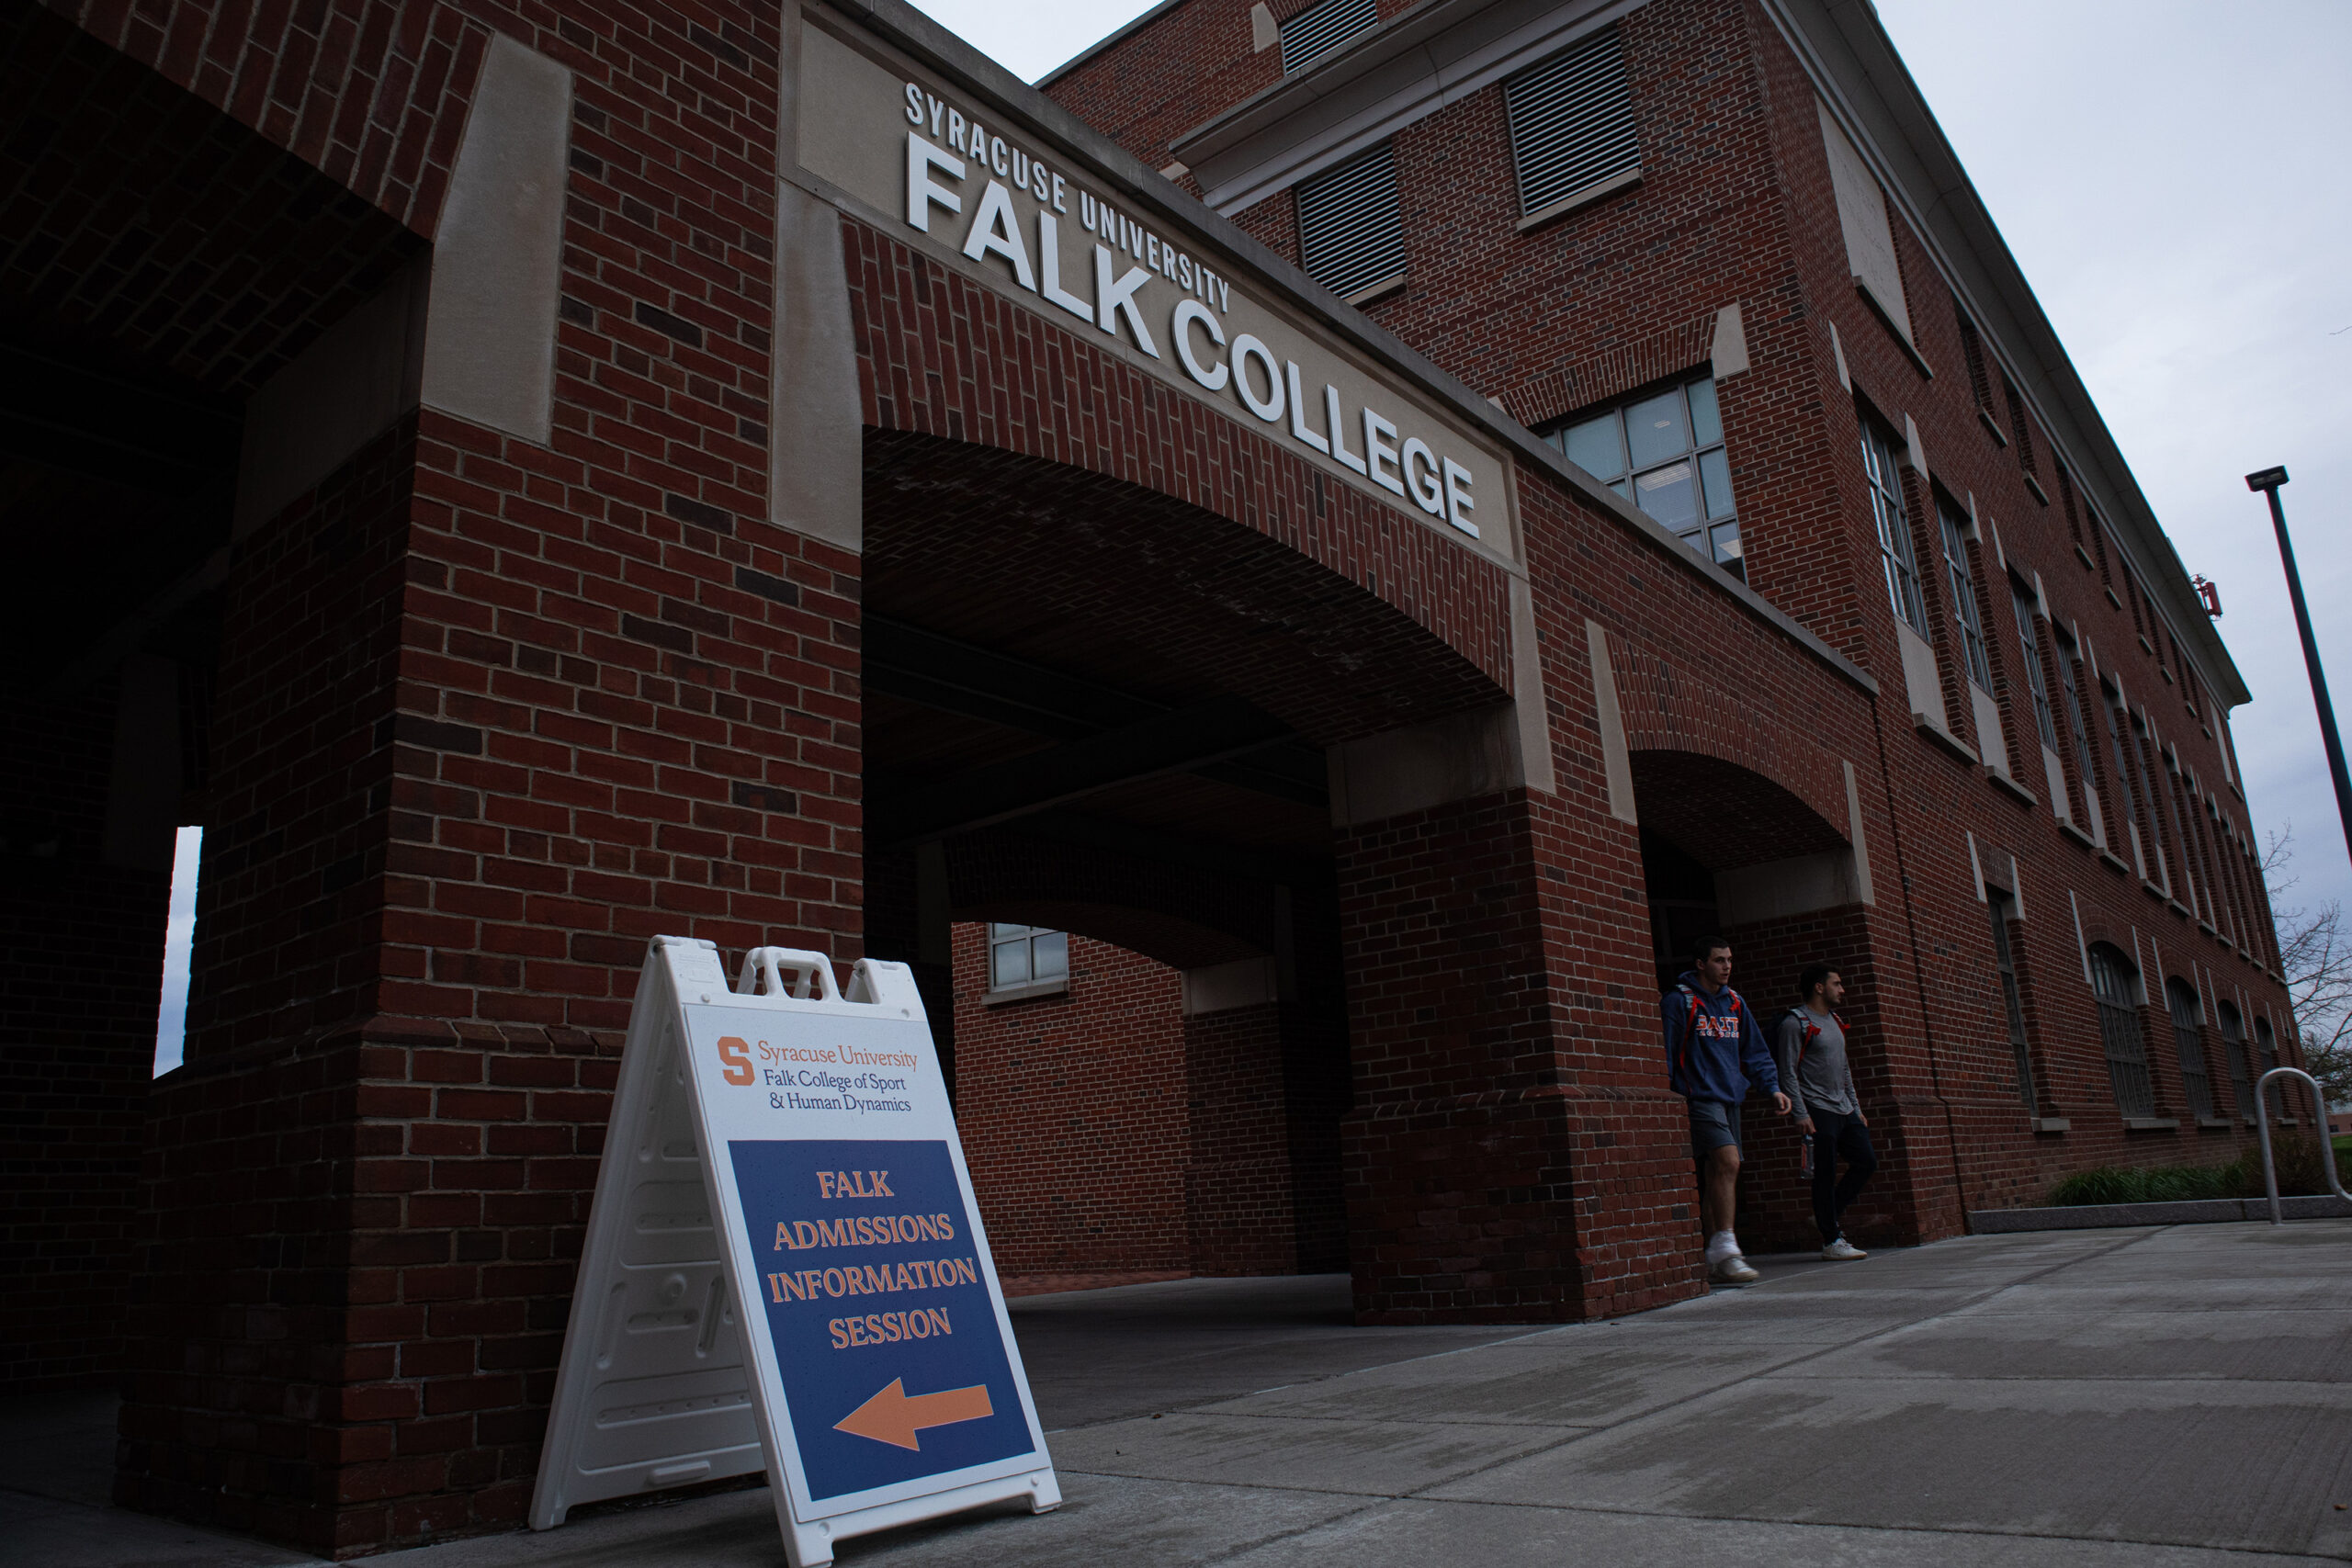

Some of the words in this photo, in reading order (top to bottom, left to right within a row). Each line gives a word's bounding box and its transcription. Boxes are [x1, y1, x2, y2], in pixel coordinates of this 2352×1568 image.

[904, 83, 1068, 214] SYRACUSE
[1080, 191, 1229, 313] UNIVERSITY
[907, 131, 1159, 359] FALK
[1172, 299, 1480, 540] COLLEGE
[758, 1040, 836, 1066] Syracuse
[838, 1044, 917, 1072] University
[763, 1068, 796, 1087] Falk
[798, 1070, 853, 1092] College
[854, 1073, 868, 1089] of
[869, 1073, 907, 1093] Sport
[770, 1092, 784, 1110] &
[787, 1092, 842, 1111] Human
[844, 1094, 911, 1115] Dynamics
[817, 1170, 895, 1199] FALK
[774, 1213, 956, 1251] ADMISSIONS
[767, 1257, 978, 1303] INFORMATION
[829, 1307, 953, 1349] SESSION
